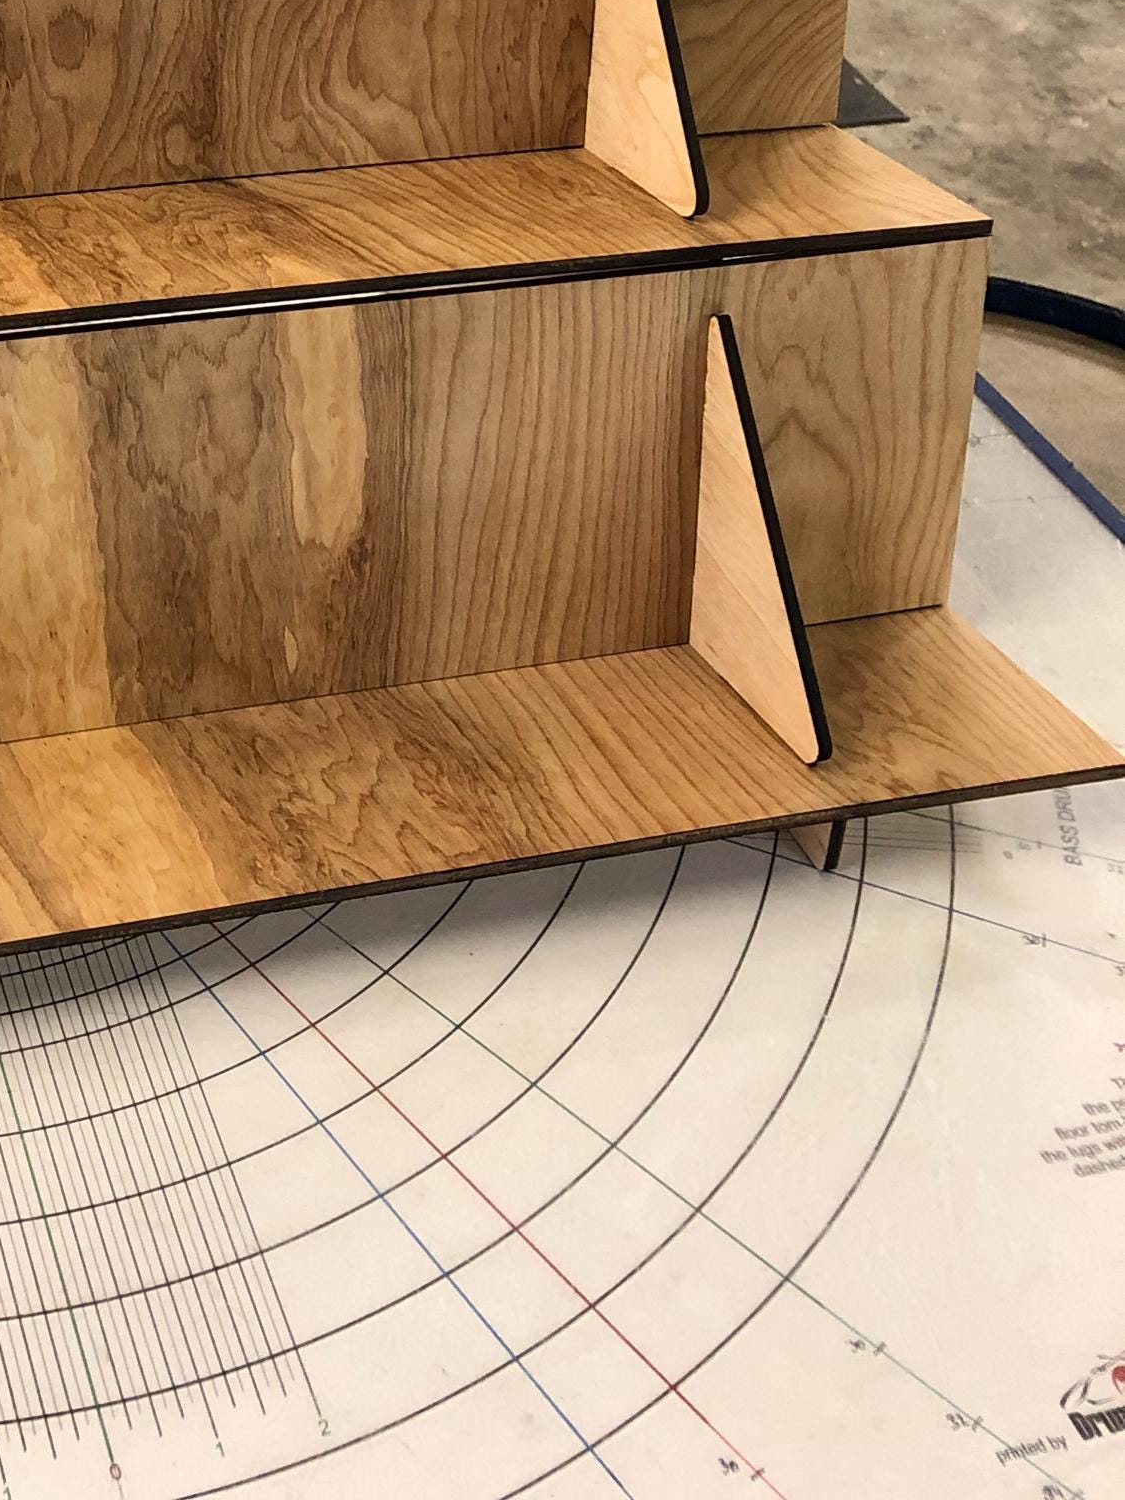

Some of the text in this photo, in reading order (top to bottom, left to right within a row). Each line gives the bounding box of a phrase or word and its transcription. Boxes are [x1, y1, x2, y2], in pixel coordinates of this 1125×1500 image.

[1058, 824, 1084, 866] BASS
[1039, 1150, 1068, 1164] the
[318, 1418, 331, 1437] 2
[995, 1437, 1049, 1468] printed
[1046, 1435, 1069, 1453] by
